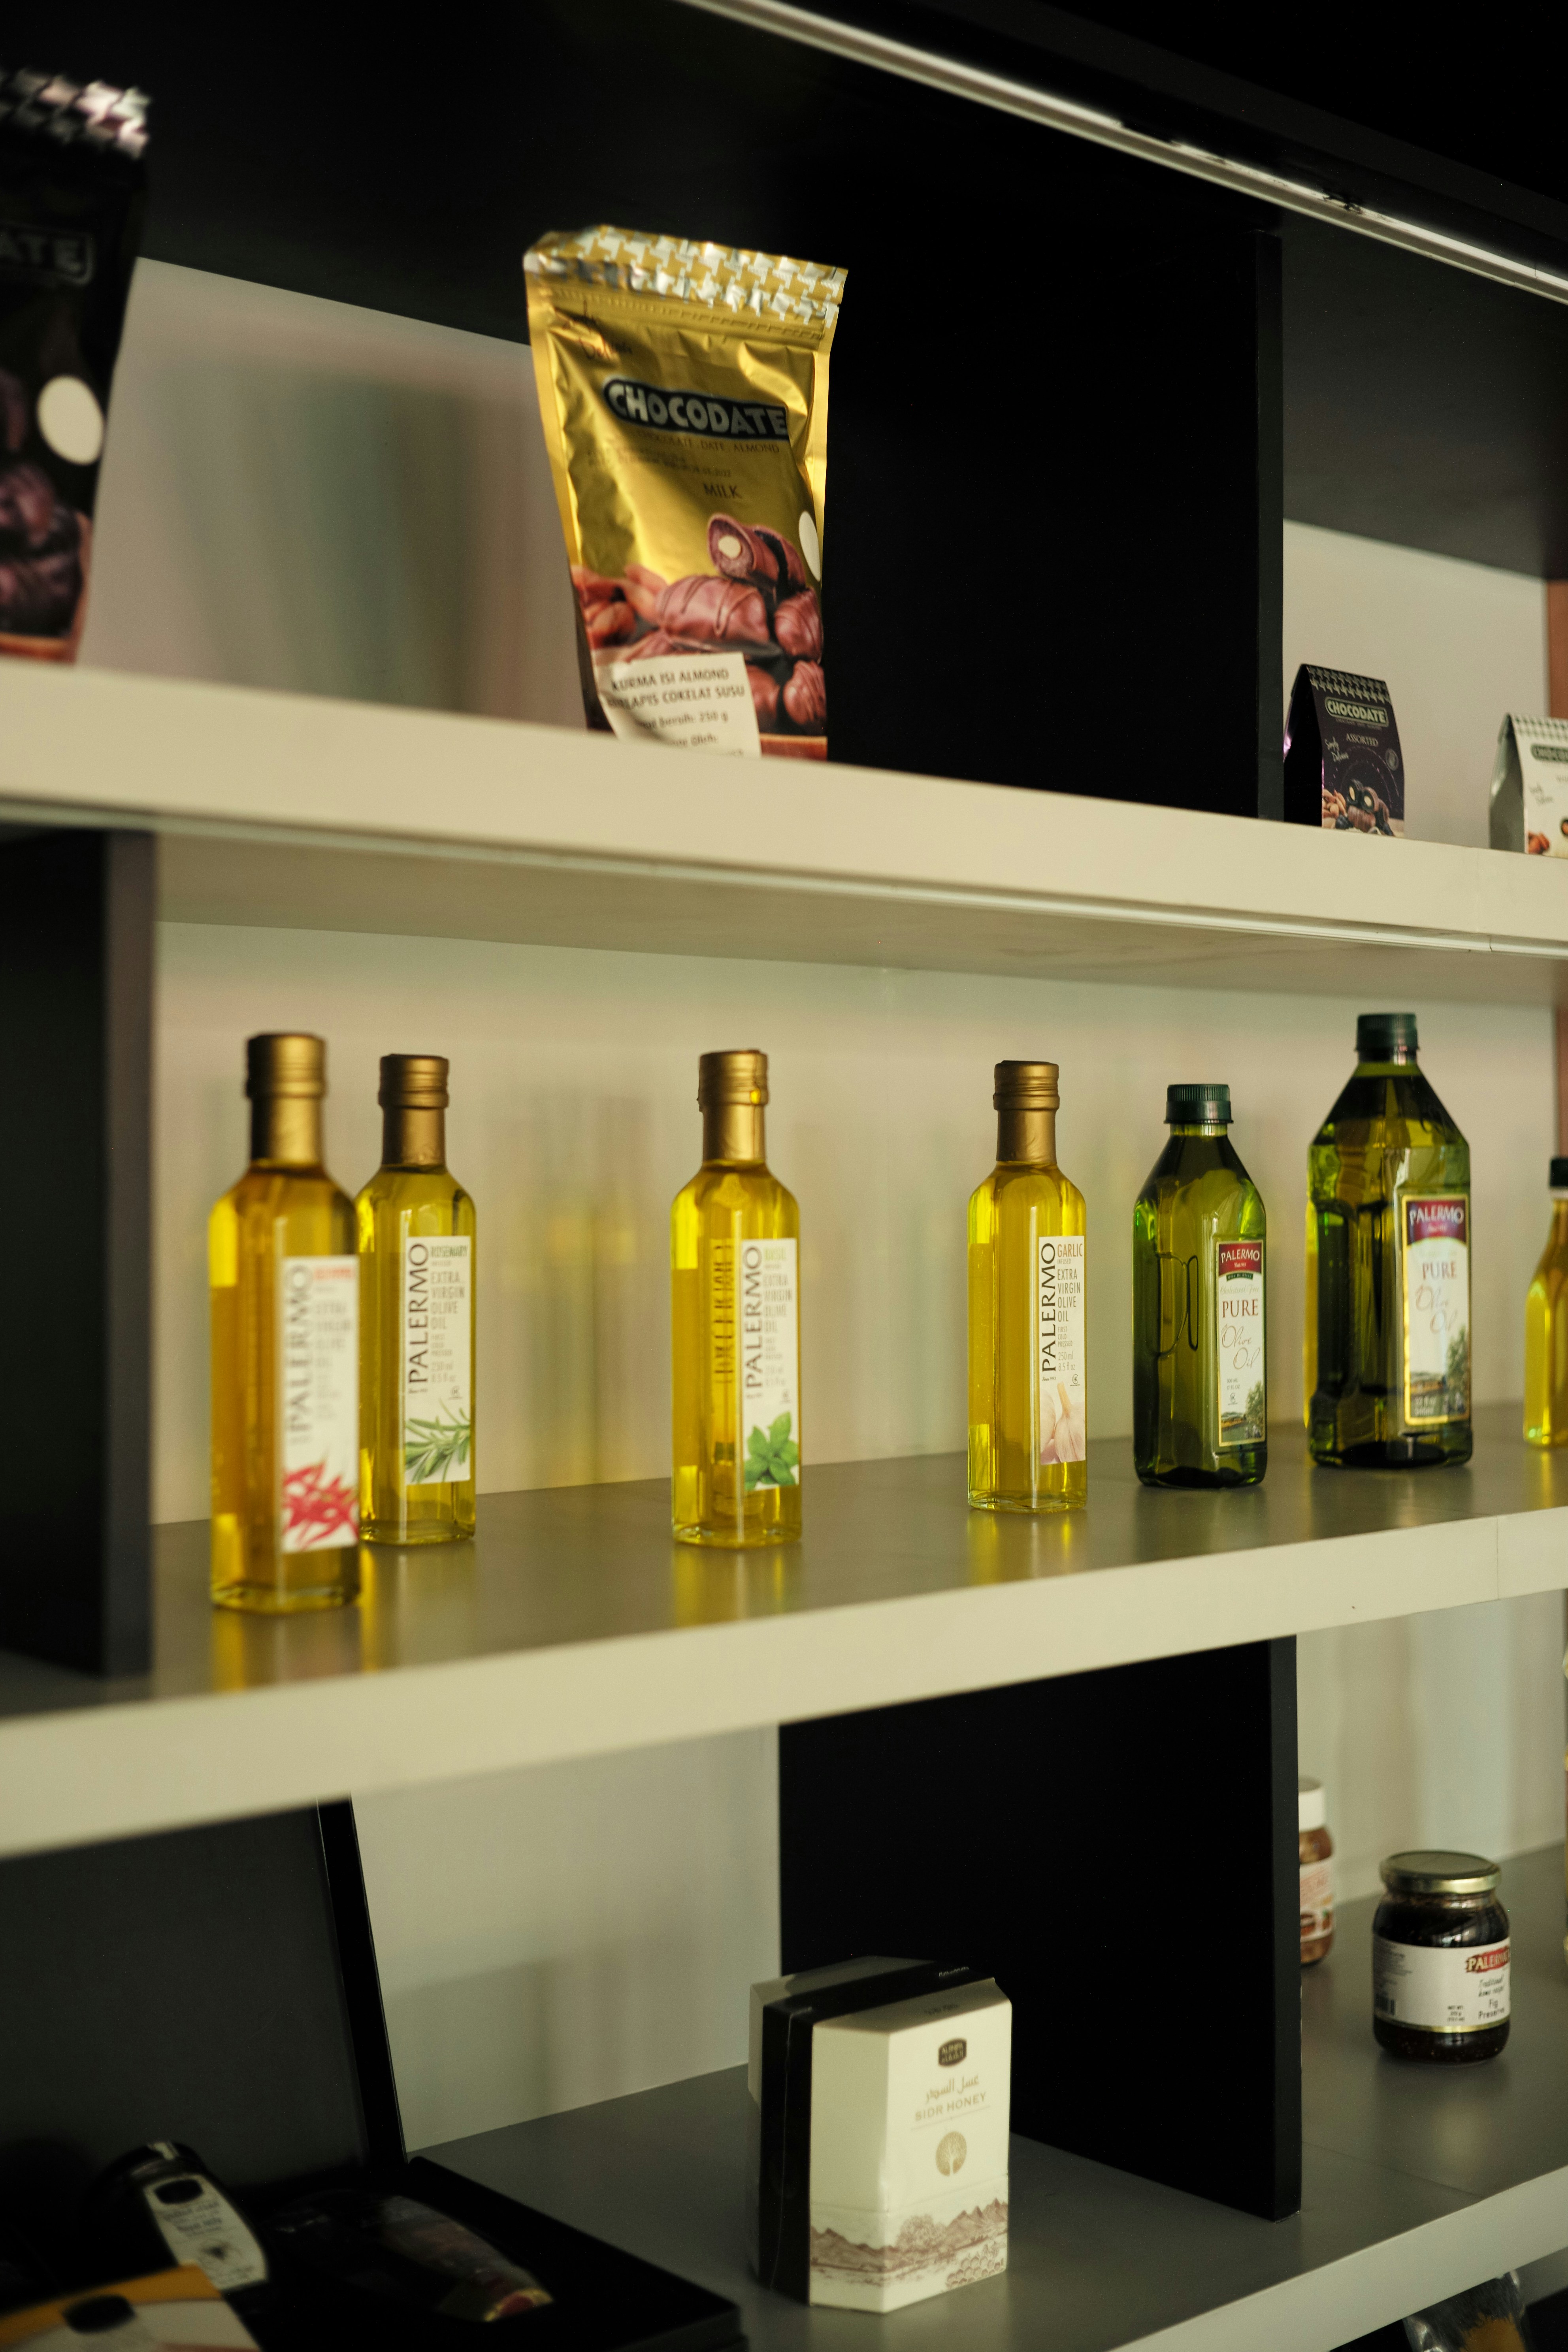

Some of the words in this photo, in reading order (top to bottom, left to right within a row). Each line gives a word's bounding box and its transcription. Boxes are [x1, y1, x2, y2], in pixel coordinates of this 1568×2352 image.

[609, 383, 788, 435] CHOCODATE
[733, 443, 780, 453] ALMOND
[703, 483, 742, 499] MILK
[660, 671, 675, 684] ISI
[679, 668, 729, 683] ALMOND
[662, 687, 712, 705] COKELAT
[714, 685, 745, 699] SUSU
[1327, 700, 1386, 724] CHOCODATE
[1346, 733, 1379, 747] ASSORTED
[1409, 1205, 1464, 1226] PALERMO
[1057, 1243, 1083, 1257] GARLIC
[1221, 1248, 1260, 1264] PALERMO
[1057, 1268, 1078, 1280] EXTRA
[1423, 1261, 1457, 1280] PURE
[1057, 1282, 1081, 1294] VIRGIN
[1041, 1243, 1056, 1371] PALERMO
[1057, 1296, 1076, 1308] OLIVE
[1222, 1298, 1258, 1318] PURE
[409, 1243, 429, 1383] PALERMO
[743, 1246, 763, 1388] PALERMO
[1057, 1311, 1069, 1322] OIL
[1222, 1325, 1252, 1348] Olive
[1058, 1352, 1067, 1361] 250
[1068, 1351, 1073, 1360] ml
[1233, 1347, 1261, 1370] Oil
[1488, 1999, 1498, 2008] Fig
[915, 2105, 943, 2121] SIDR
[947, 2092, 986, 2112] HONEY
